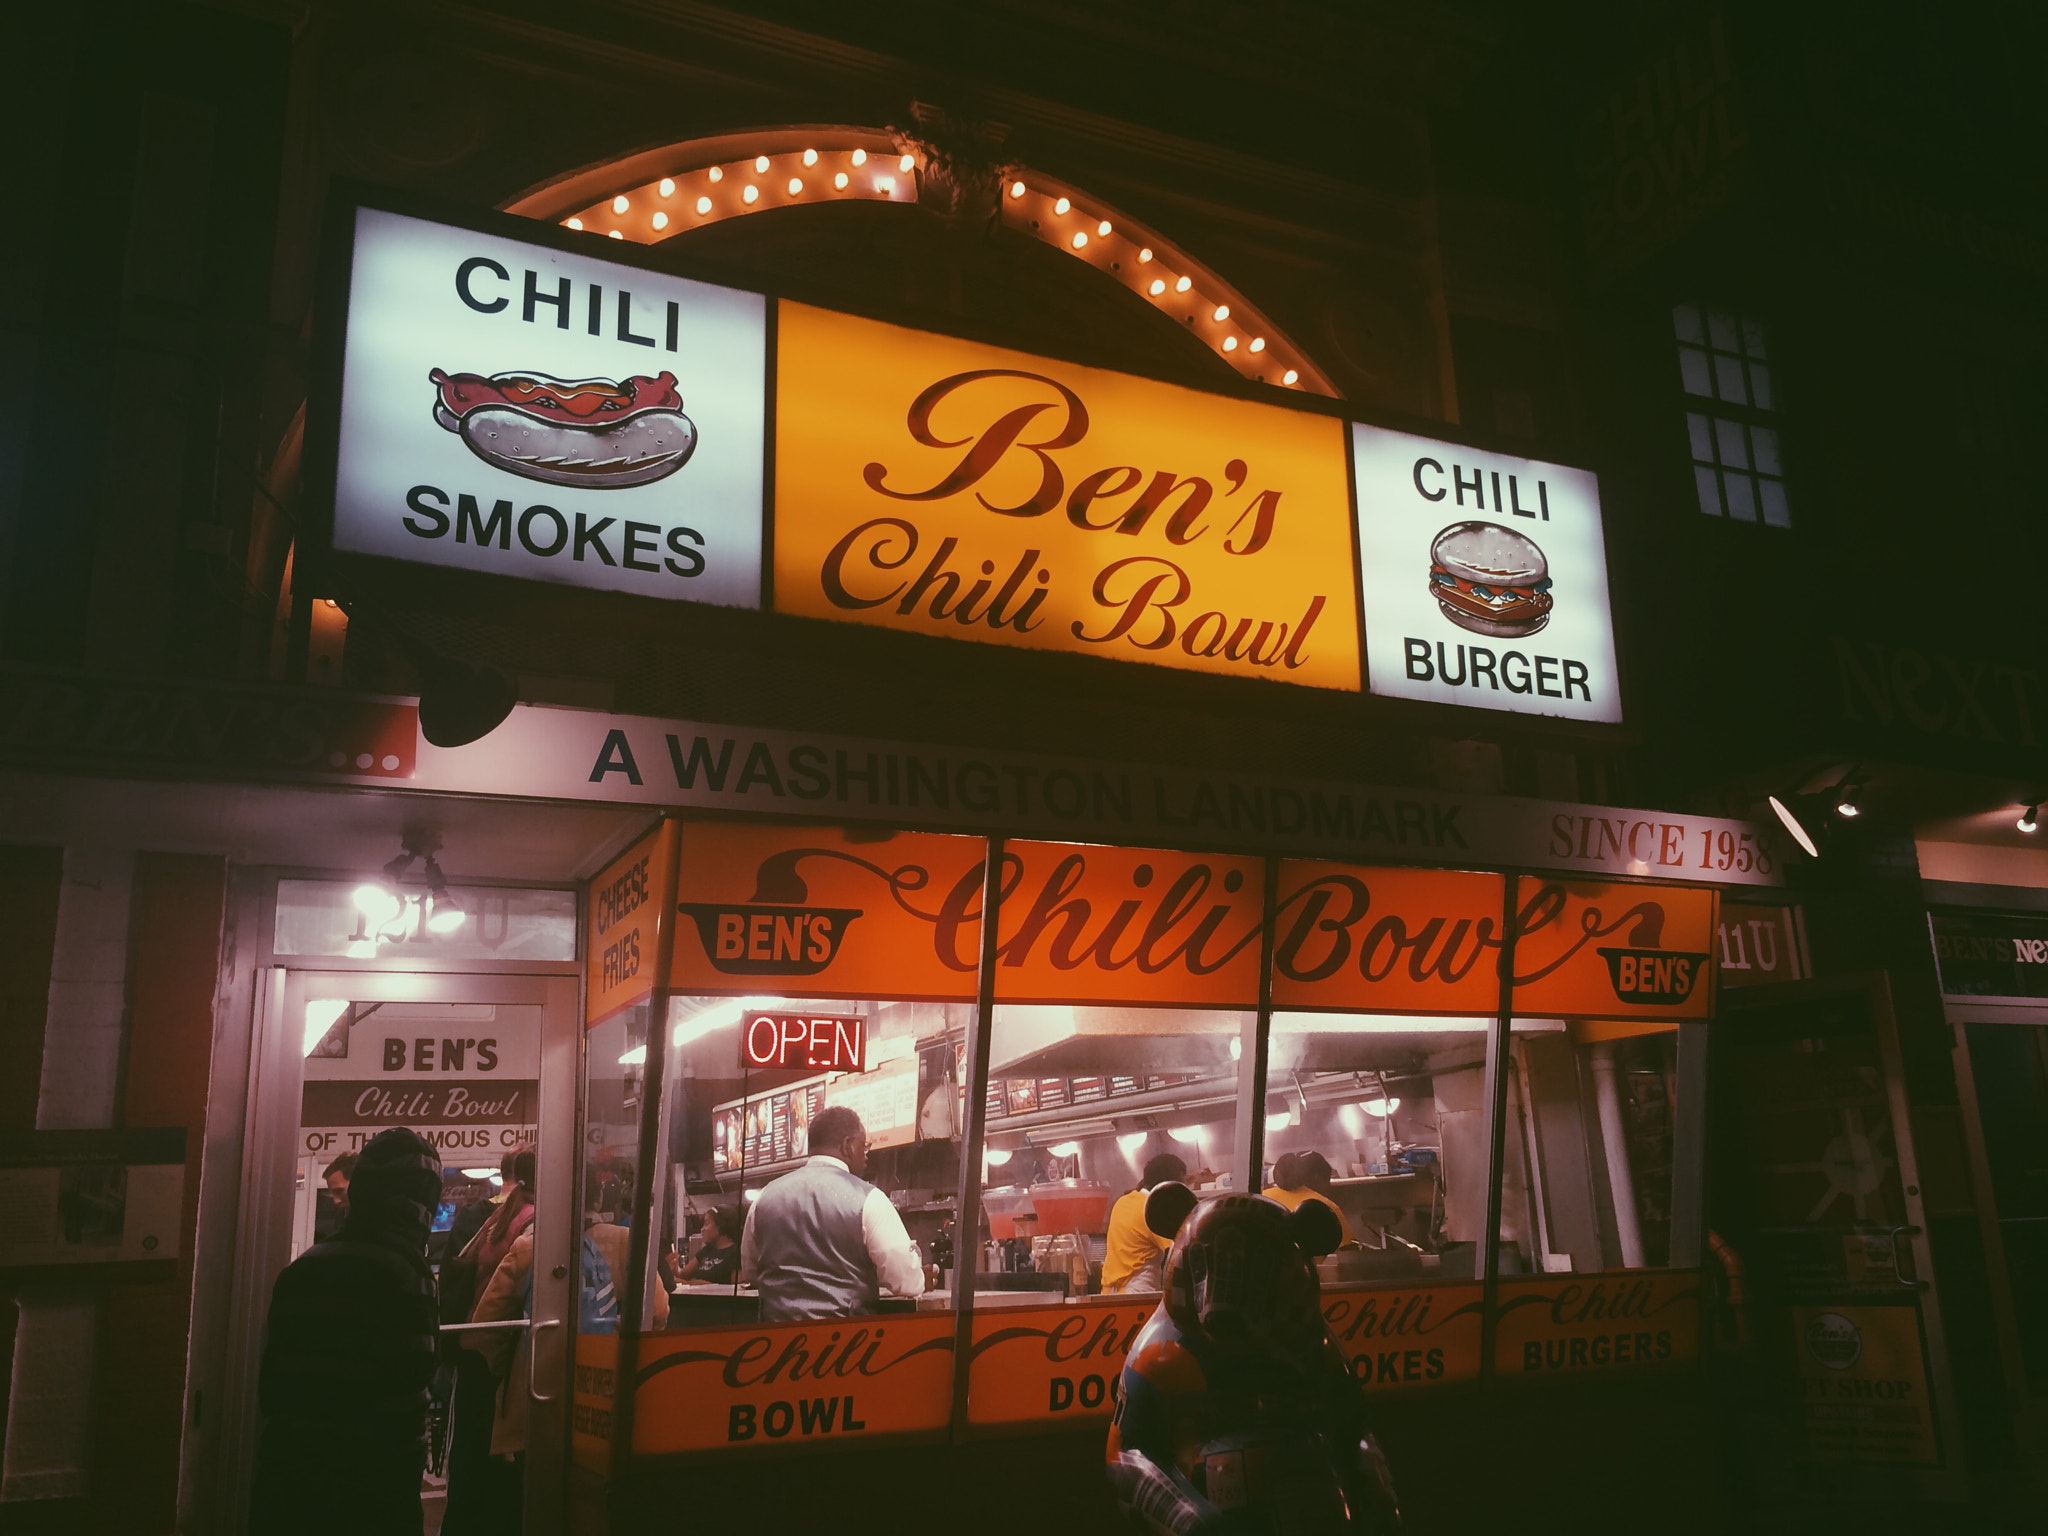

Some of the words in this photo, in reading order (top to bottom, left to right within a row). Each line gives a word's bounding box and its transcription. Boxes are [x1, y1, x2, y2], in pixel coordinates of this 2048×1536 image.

[455, 256, 680, 353] CHILI
[863, 368, 1283, 556] Ben's
[1412, 456, 1551, 522] CHILI
[402, 485, 706, 578] SMOKES
[820, 517, 1050, 633] Chili
[1071, 556, 1327, 669] Bowl
[1403, 636, 1592, 702] BURGER
[588, 728, 644, 786] A
[665, 732, 1130, 824] WASHINGTON
[1155, 776, 1470, 850] LANDMARK
[1548, 811, 1686, 868] SINCE
[1698, 828, 1774, 876] 1958
[597, 855, 650, 936] CHEESE
[933, 852, 1248, 976] Chili
[1274, 874, 1570, 987] Bowl
[602, 927, 640, 994] FRIES
[716, 912, 833, 962] BEN'S
[1619, 956, 1691, 996] BEN'S
[382, 1038, 499, 1072] BEN'S
[747, 1015, 862, 1067] OPEN
[354, 1086, 434, 1118] Chili
[442, 1086, 520, 1118] Bowl
[305, 1132, 337, 1150] OF
[347, 1131, 378, 1150] TH
[1551, 1280, 1660, 1325] Chili
[721, 1327, 893, 1388] Chili
[1045, 1312, 1146, 1363] Chi
[1523, 1331, 1673, 1372] BURGERS
[1353, 1348, 1444, 1384] OKES
[1838, 1379, 1912, 1399] SHOP
[727, 1395, 866, 1442] BOWL
